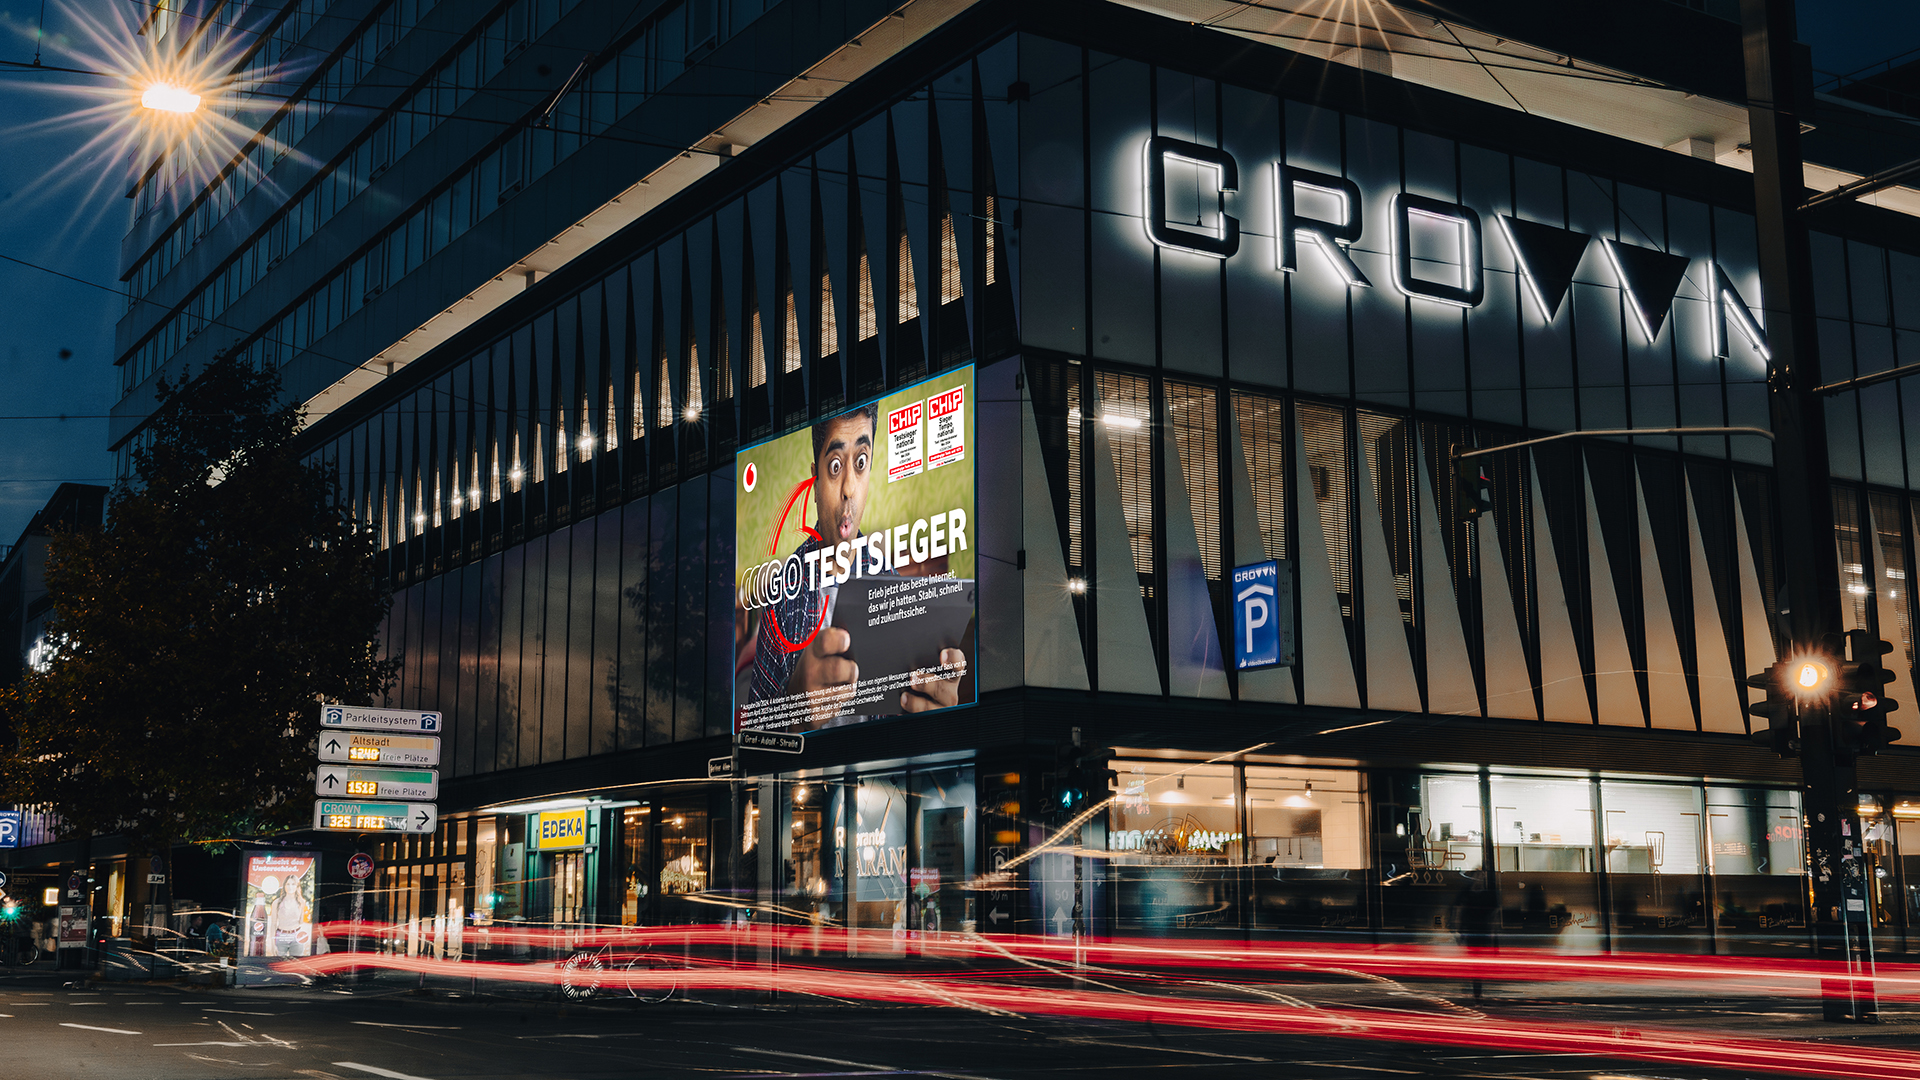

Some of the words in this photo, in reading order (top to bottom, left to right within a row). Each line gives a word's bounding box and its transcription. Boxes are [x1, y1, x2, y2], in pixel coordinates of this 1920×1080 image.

[929, 389, 962, 419] CHIP
[890, 404, 921, 433] CHIP
[894, 429, 917, 442] Testsieger
[805, 507, 968, 591] TESTSIEGER
[868, 588, 884, 600] Erleb
[884, 584, 898, 598] jetzt
[900, 581, 910, 592] das
[911, 577, 928, 589] beste
[928, 569, 956, 584] Internet,
[868, 603, 878, 614] das
[879, 600, 889, 610] wir
[888, 598, 895, 611] je
[895, 594, 917, 607] hatten.
[919, 587, 938, 601] Stabil,
[939, 581, 963, 596] schnell
[868, 615, 880, 627] und
[880, 606, 927, 624] zukunftssicher.
[346, 712, 417, 726] Parkleitsystem
[352, 736, 390, 746] Altstadt
[382, 752, 401, 761] freie
[404, 753, 428, 762] Plätze
[347, 781, 377, 794] 1512
[381, 787, 399, 795] freie
[402, 787, 426, 796] Plätze
[324, 804, 361, 814] CROWN
[329, 815, 352, 827] 325
[356, 816, 385, 828] FREI
[542, 817, 583, 839] EDEKA
